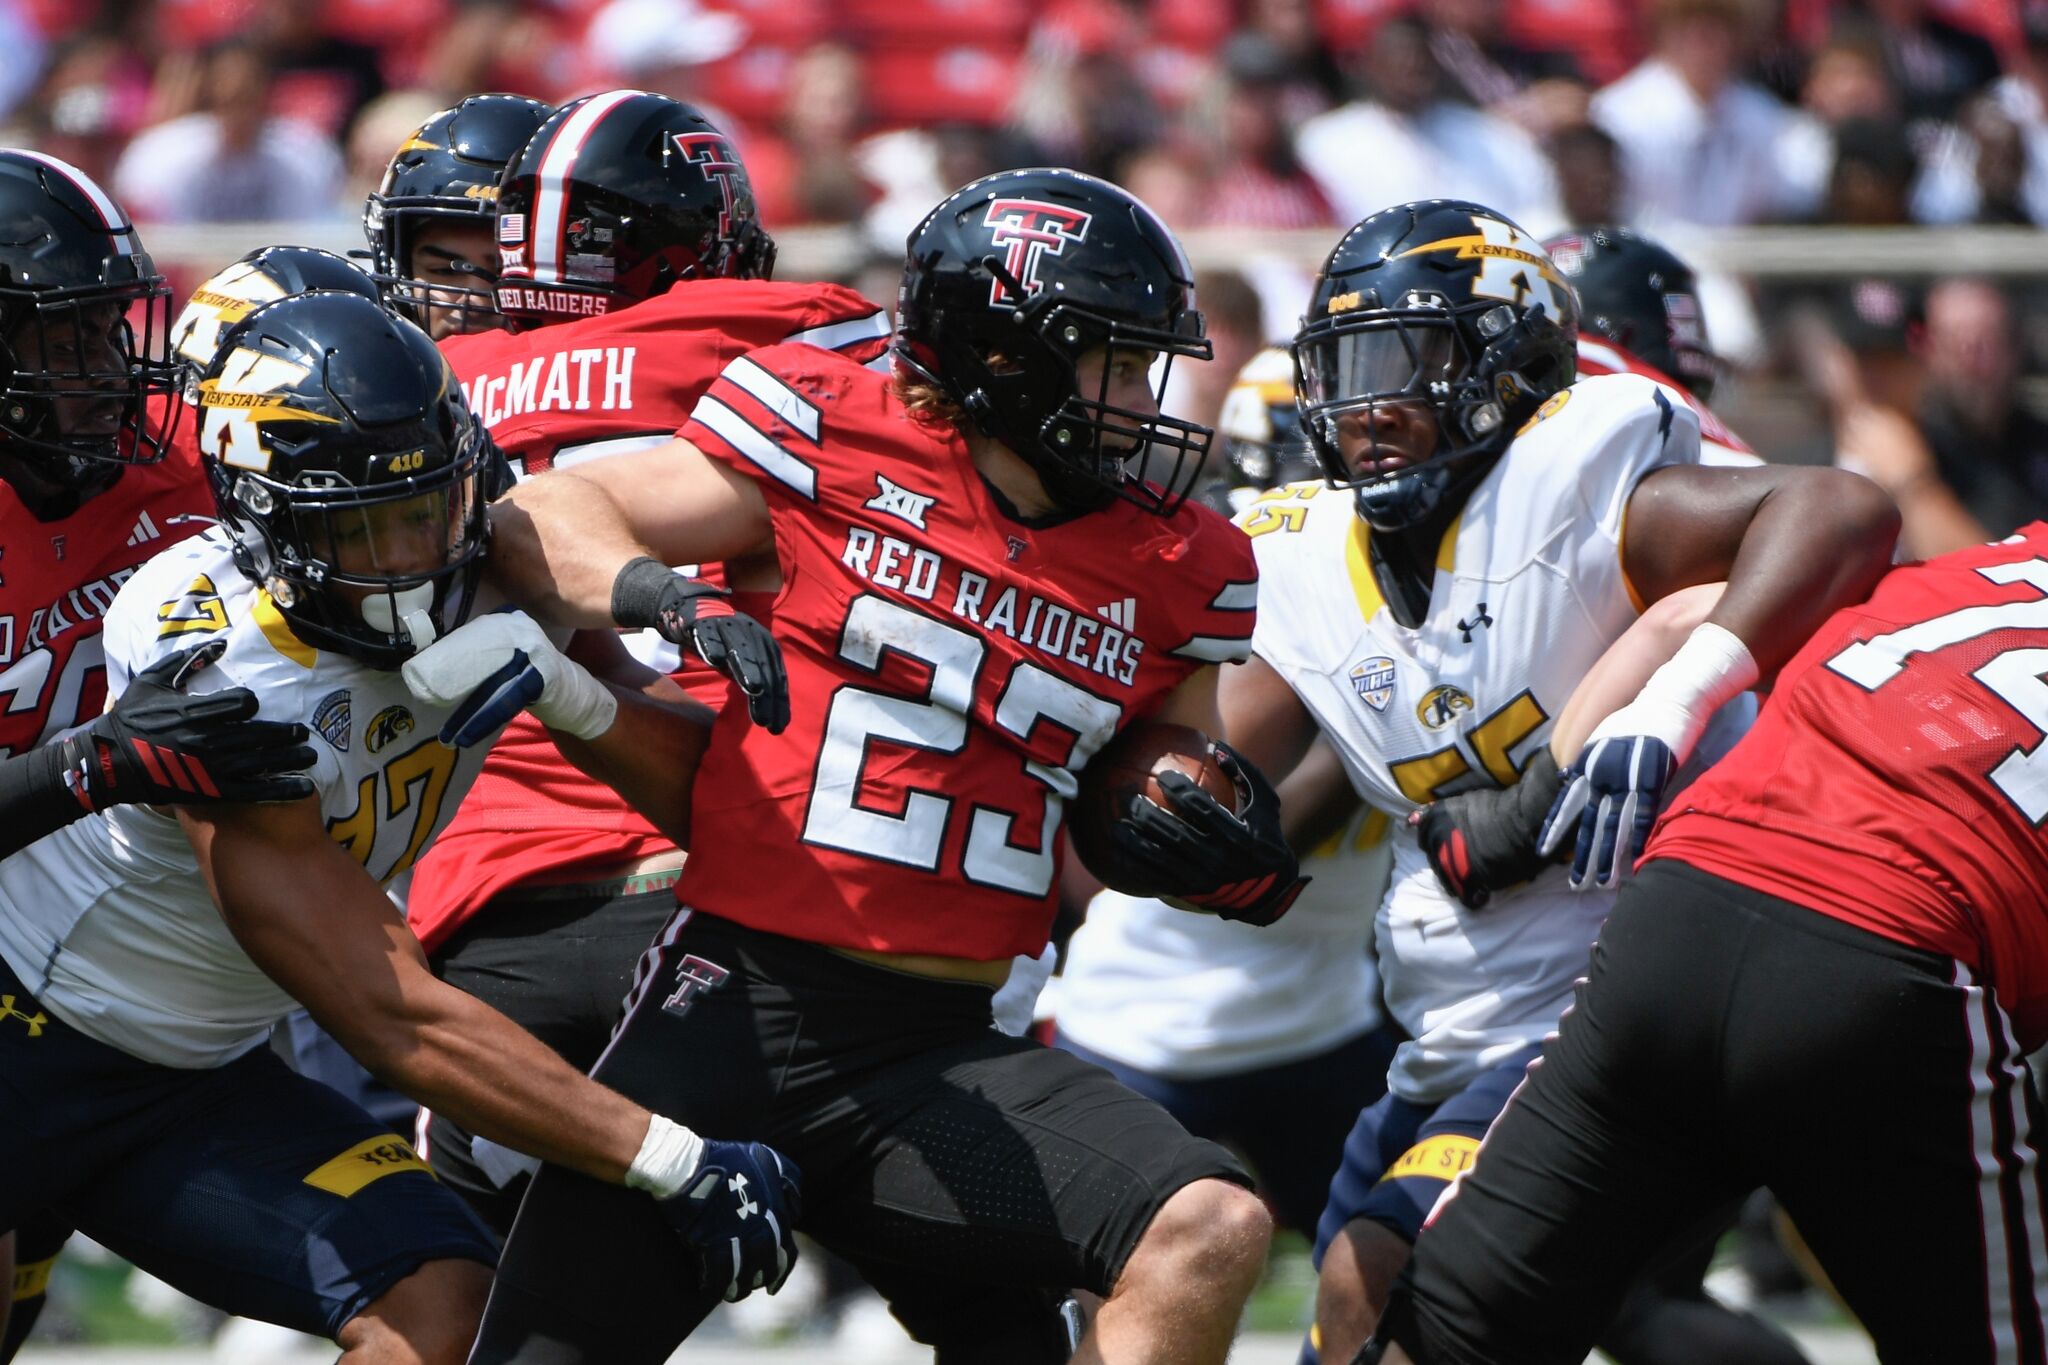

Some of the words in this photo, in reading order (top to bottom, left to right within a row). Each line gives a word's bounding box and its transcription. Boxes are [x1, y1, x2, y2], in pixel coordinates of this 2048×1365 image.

[1470, 245, 1513, 257] KENT
[498, 288, 523, 309] RED
[524, 290, 607, 315] RAIDERS
[228, 393, 270, 407] STATE
[388, 451, 424, 473] 410
[841, 526, 942, 602] RED
[952, 570, 1146, 688] RAIDERS
[800, 592, 1124, 898] 23
